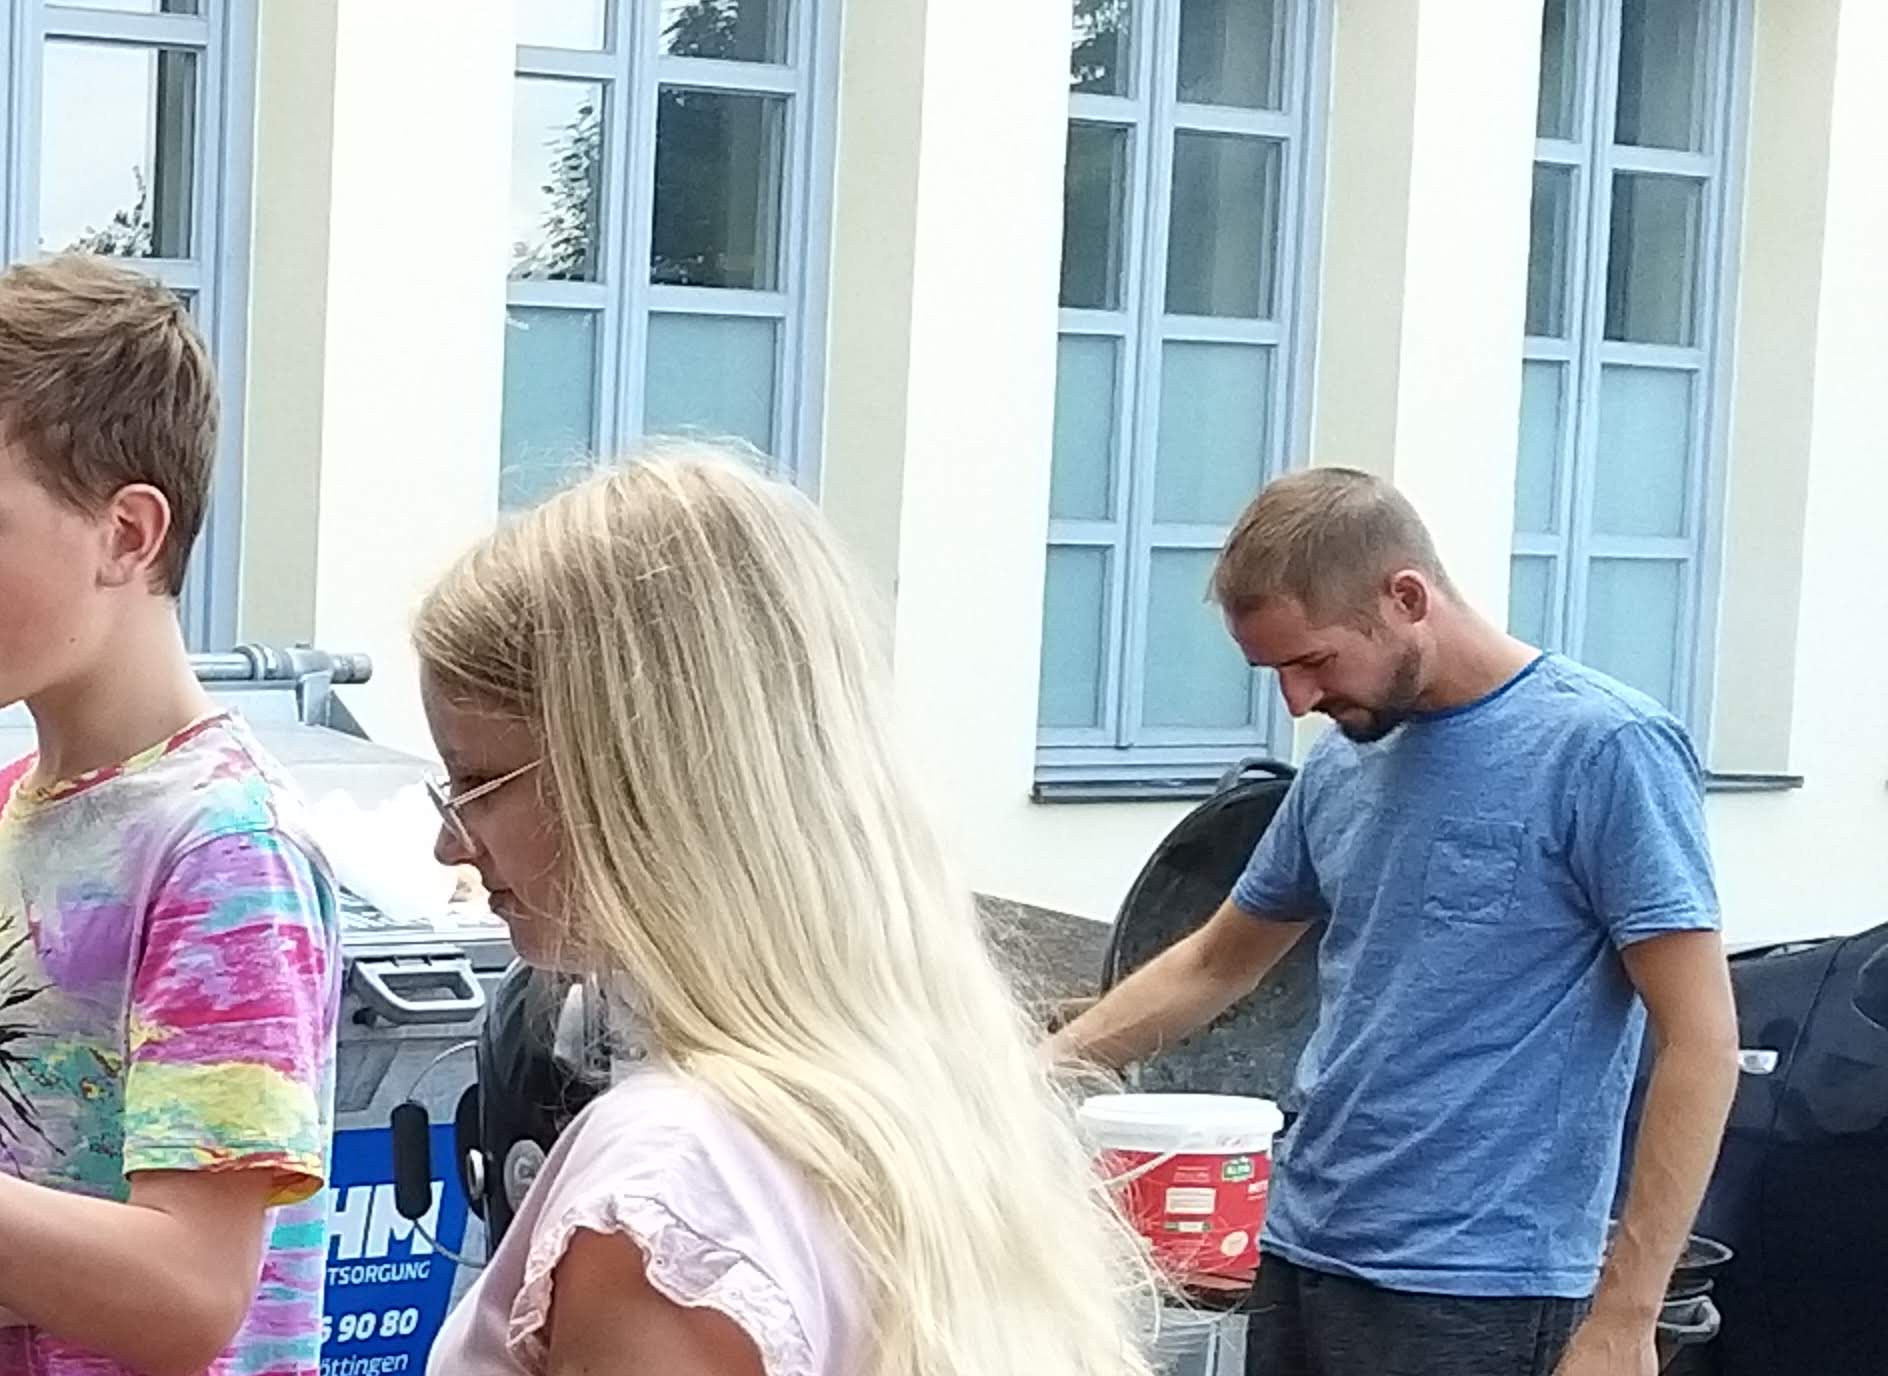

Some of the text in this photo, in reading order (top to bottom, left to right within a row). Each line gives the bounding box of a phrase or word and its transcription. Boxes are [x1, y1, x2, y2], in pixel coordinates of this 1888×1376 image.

[327, 1180, 445, 1260] HM
[327, 1260, 431, 1287] TSORGUNG
[336, 1312, 376, 1343] 90
[379, 1307, 419, 1337] 80
